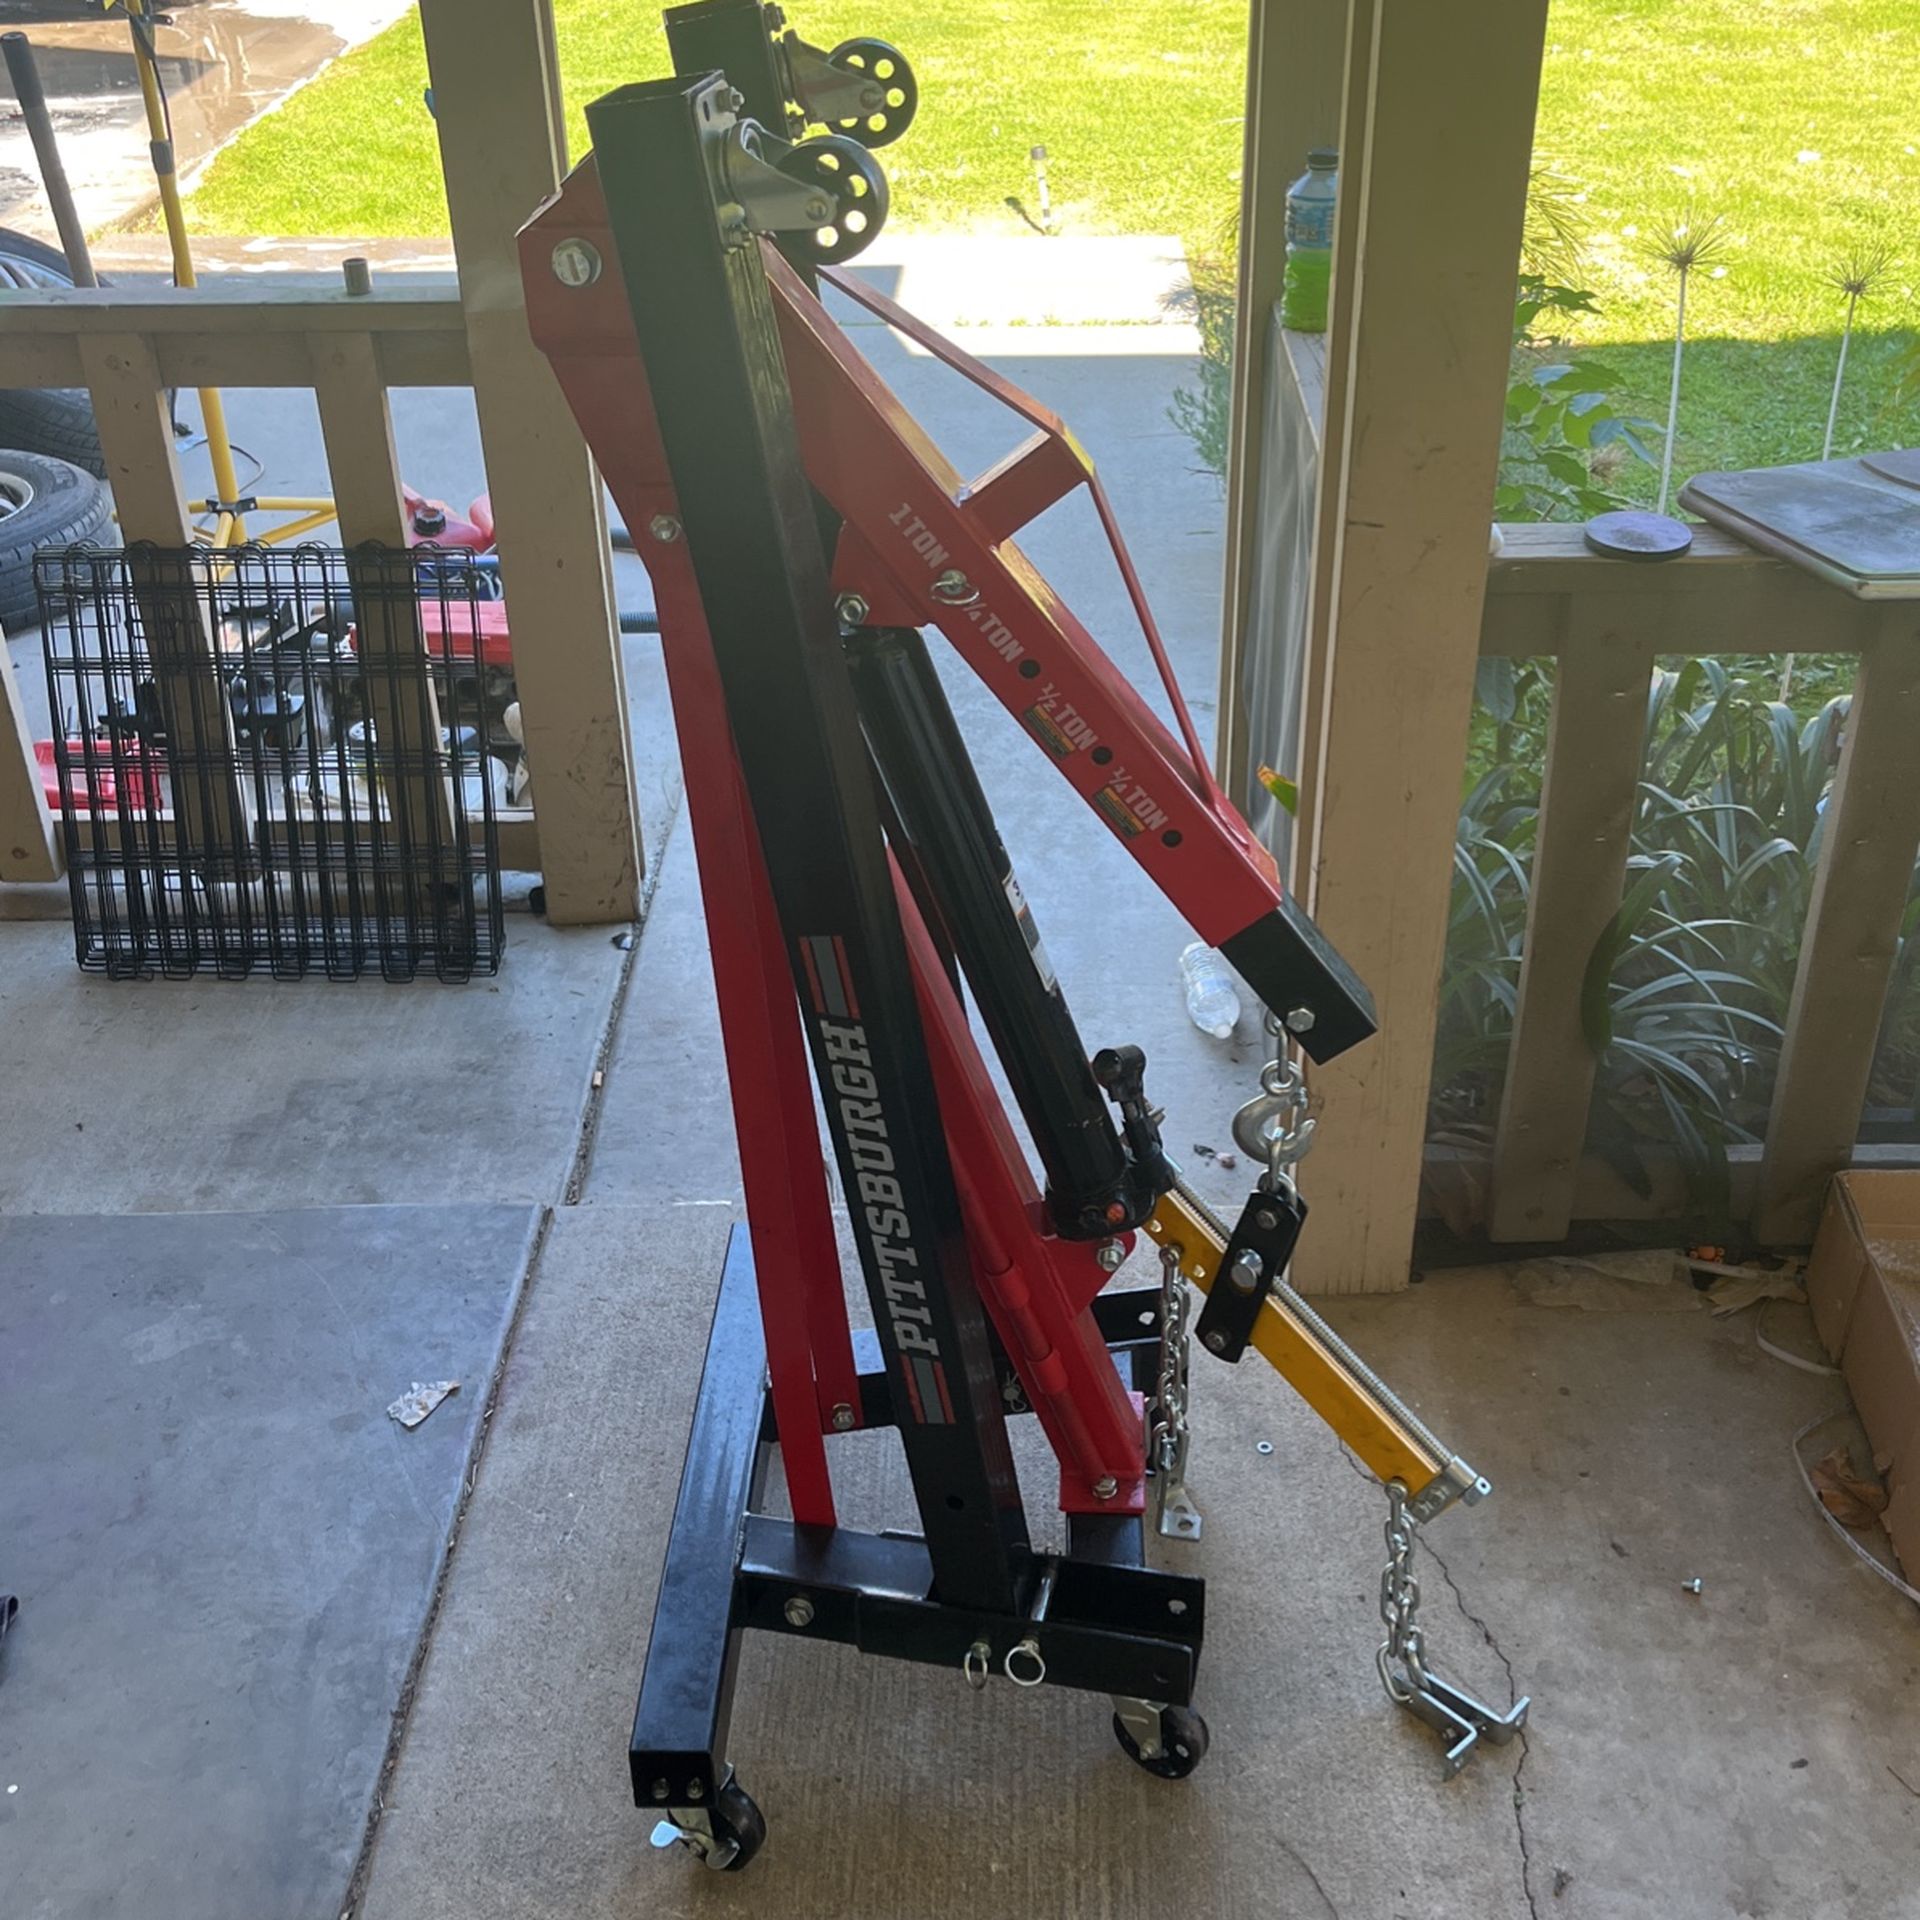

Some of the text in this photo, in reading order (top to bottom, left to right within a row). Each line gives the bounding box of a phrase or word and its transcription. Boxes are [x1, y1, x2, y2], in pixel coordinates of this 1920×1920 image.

[888, 502, 950, 569] 1 TON
[979, 612, 1025, 663] TON
[1054, 703, 1099, 751] TON
[1125, 785, 1169, 831] TON
[820, 1019, 939, 1357] PITTSBURGH
